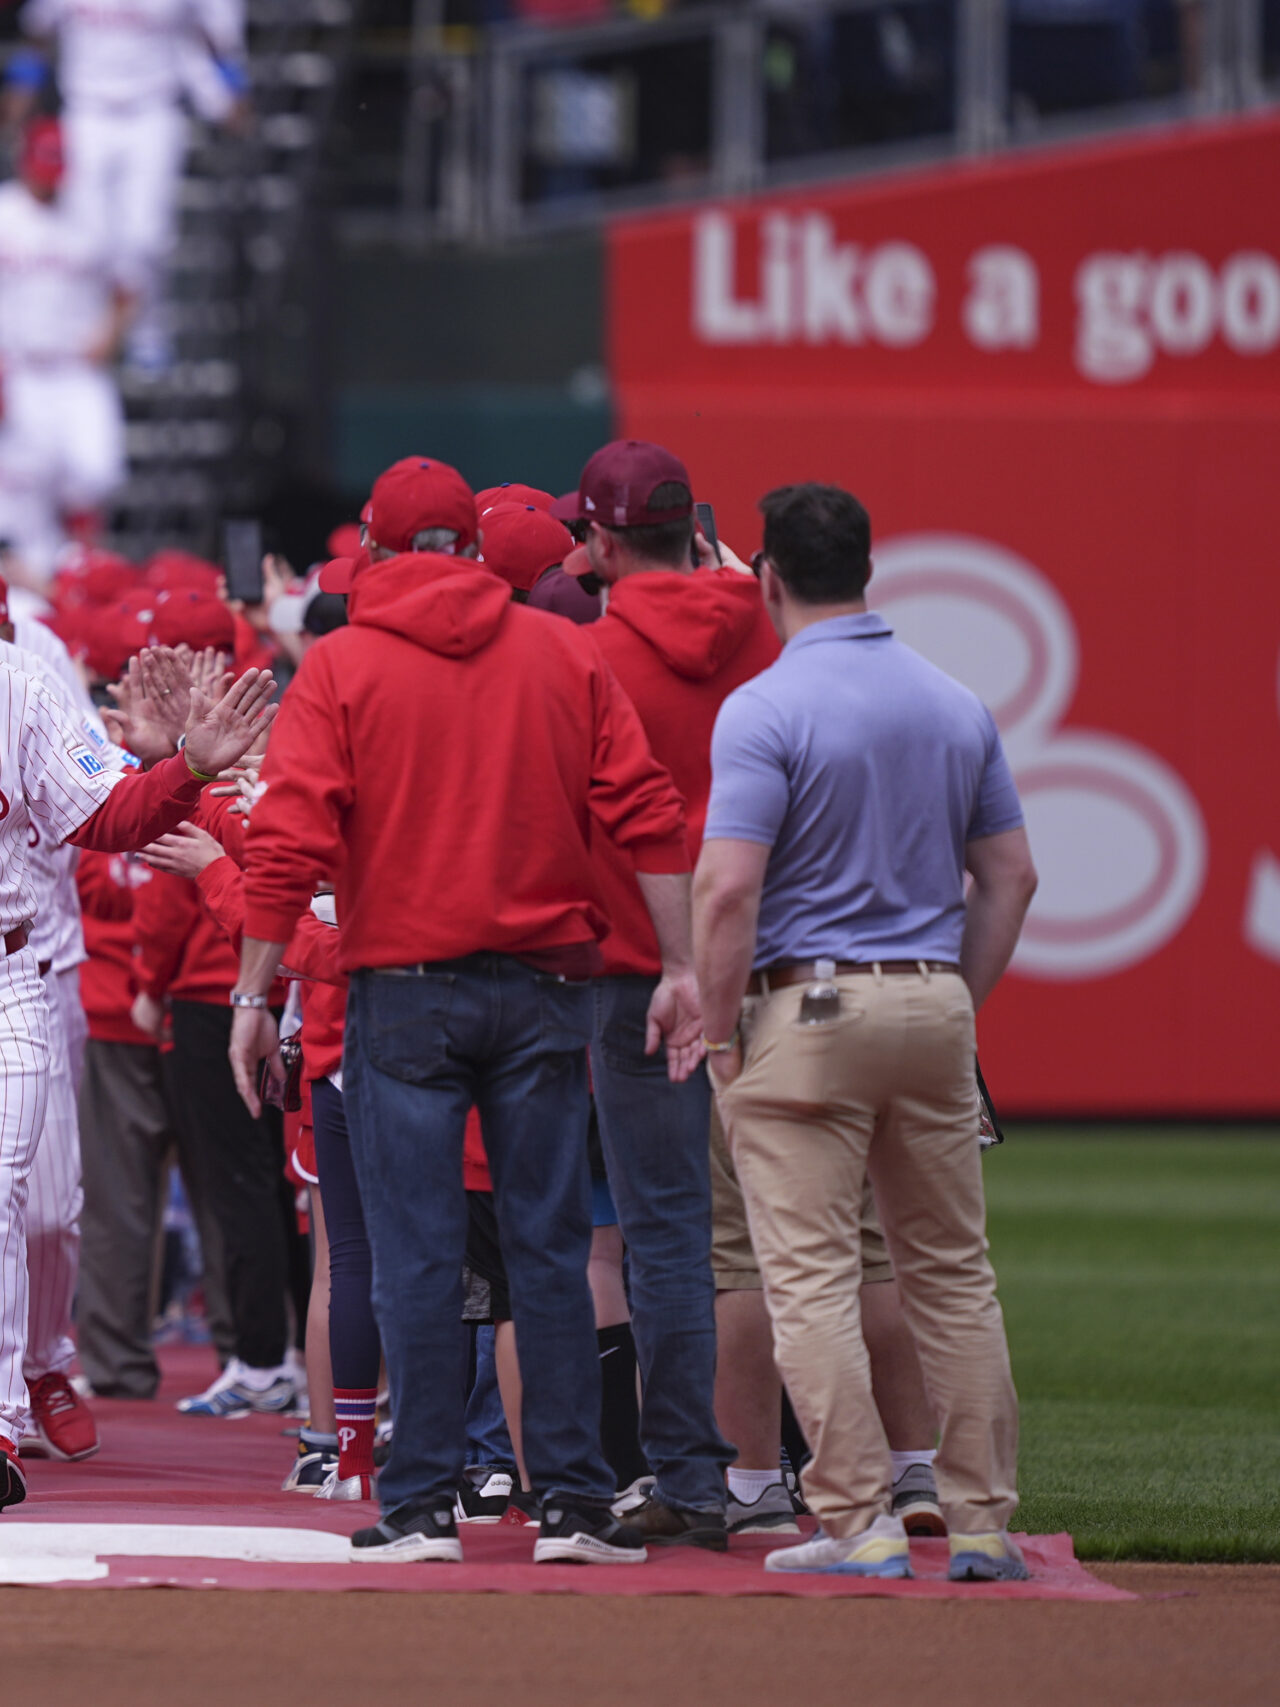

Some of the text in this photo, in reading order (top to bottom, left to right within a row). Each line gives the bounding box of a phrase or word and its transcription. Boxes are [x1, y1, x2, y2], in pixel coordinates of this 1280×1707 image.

[693, 209, 1280, 386] Like a goo
[76, 754, 105, 776] IB
[338, 1426, 357, 1452] P
